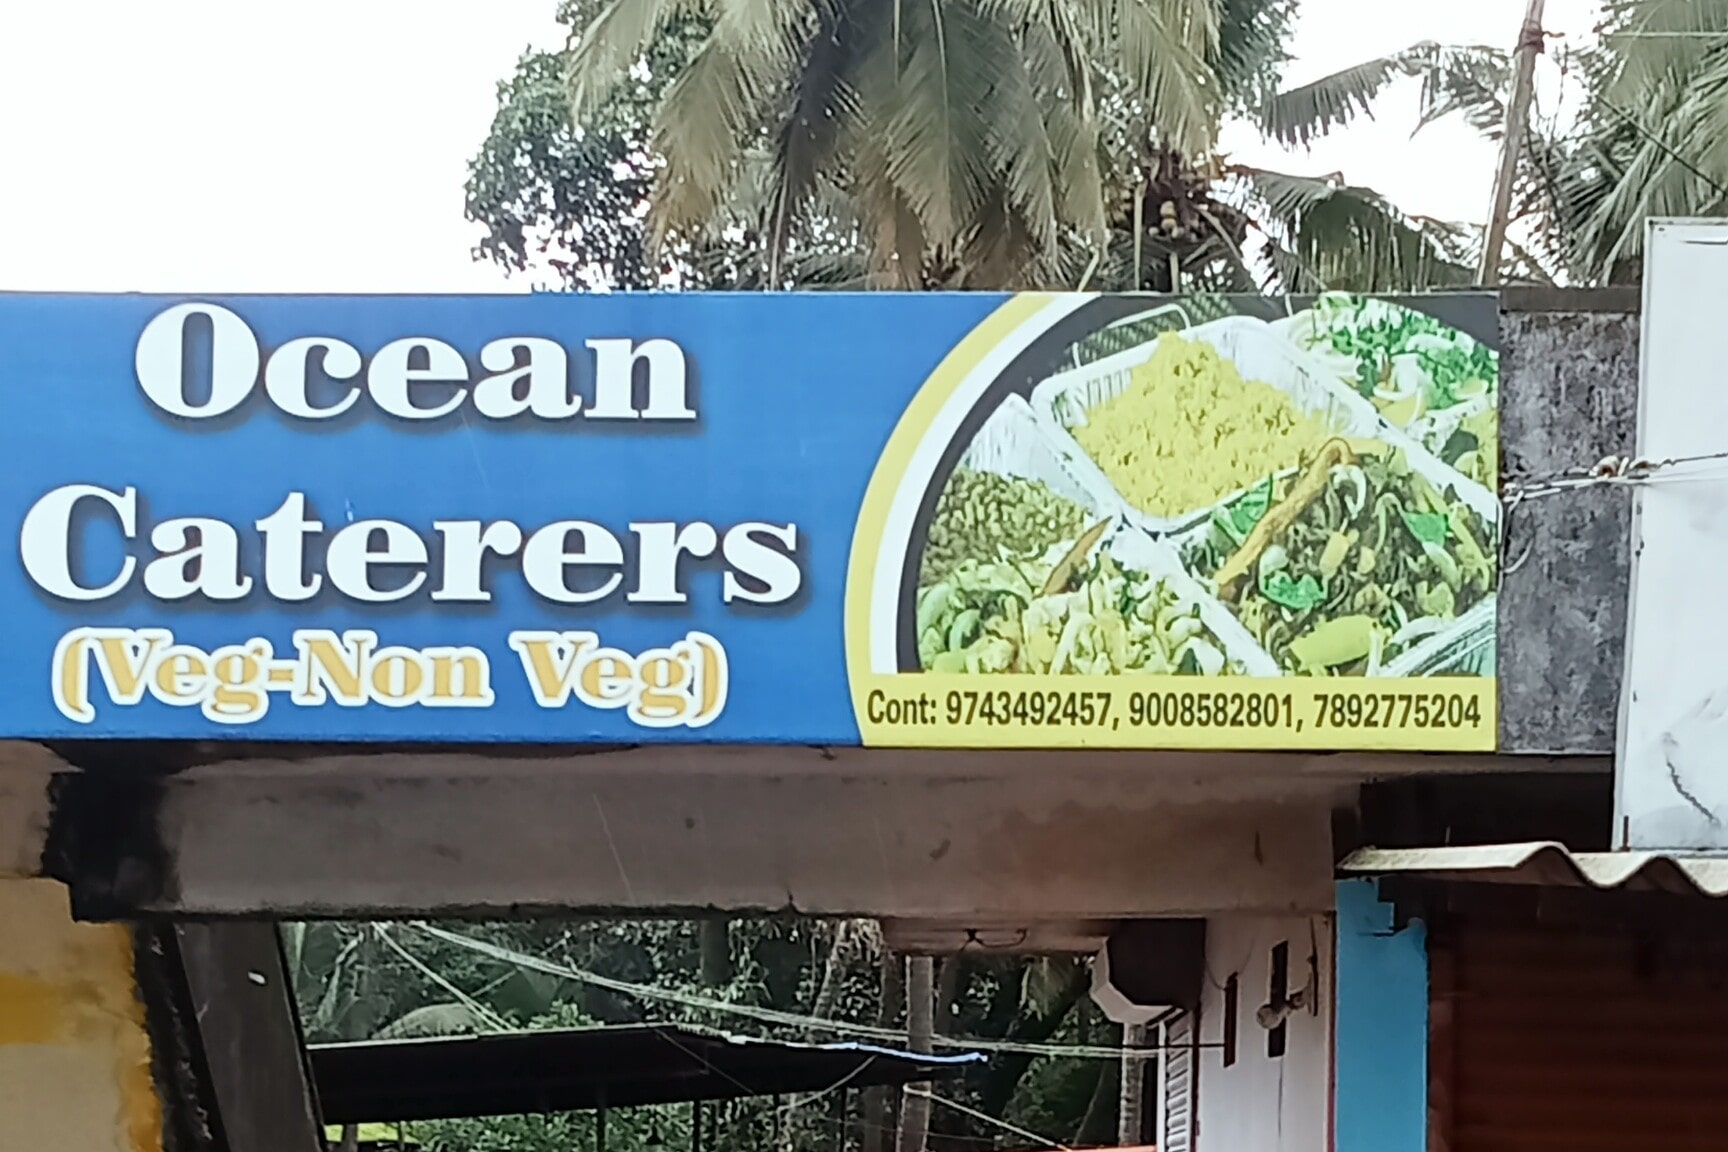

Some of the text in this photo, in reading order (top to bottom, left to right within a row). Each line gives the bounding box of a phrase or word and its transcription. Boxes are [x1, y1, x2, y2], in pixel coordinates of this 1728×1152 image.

[135, 302, 698, 421] Ocean
[20, 483, 803, 604] Caterers
[51, 627, 729, 728] (Veg-Non Veg)
[867, 688, 1481, 733] Cont: 9743492457, 9008582801, 7892775204
